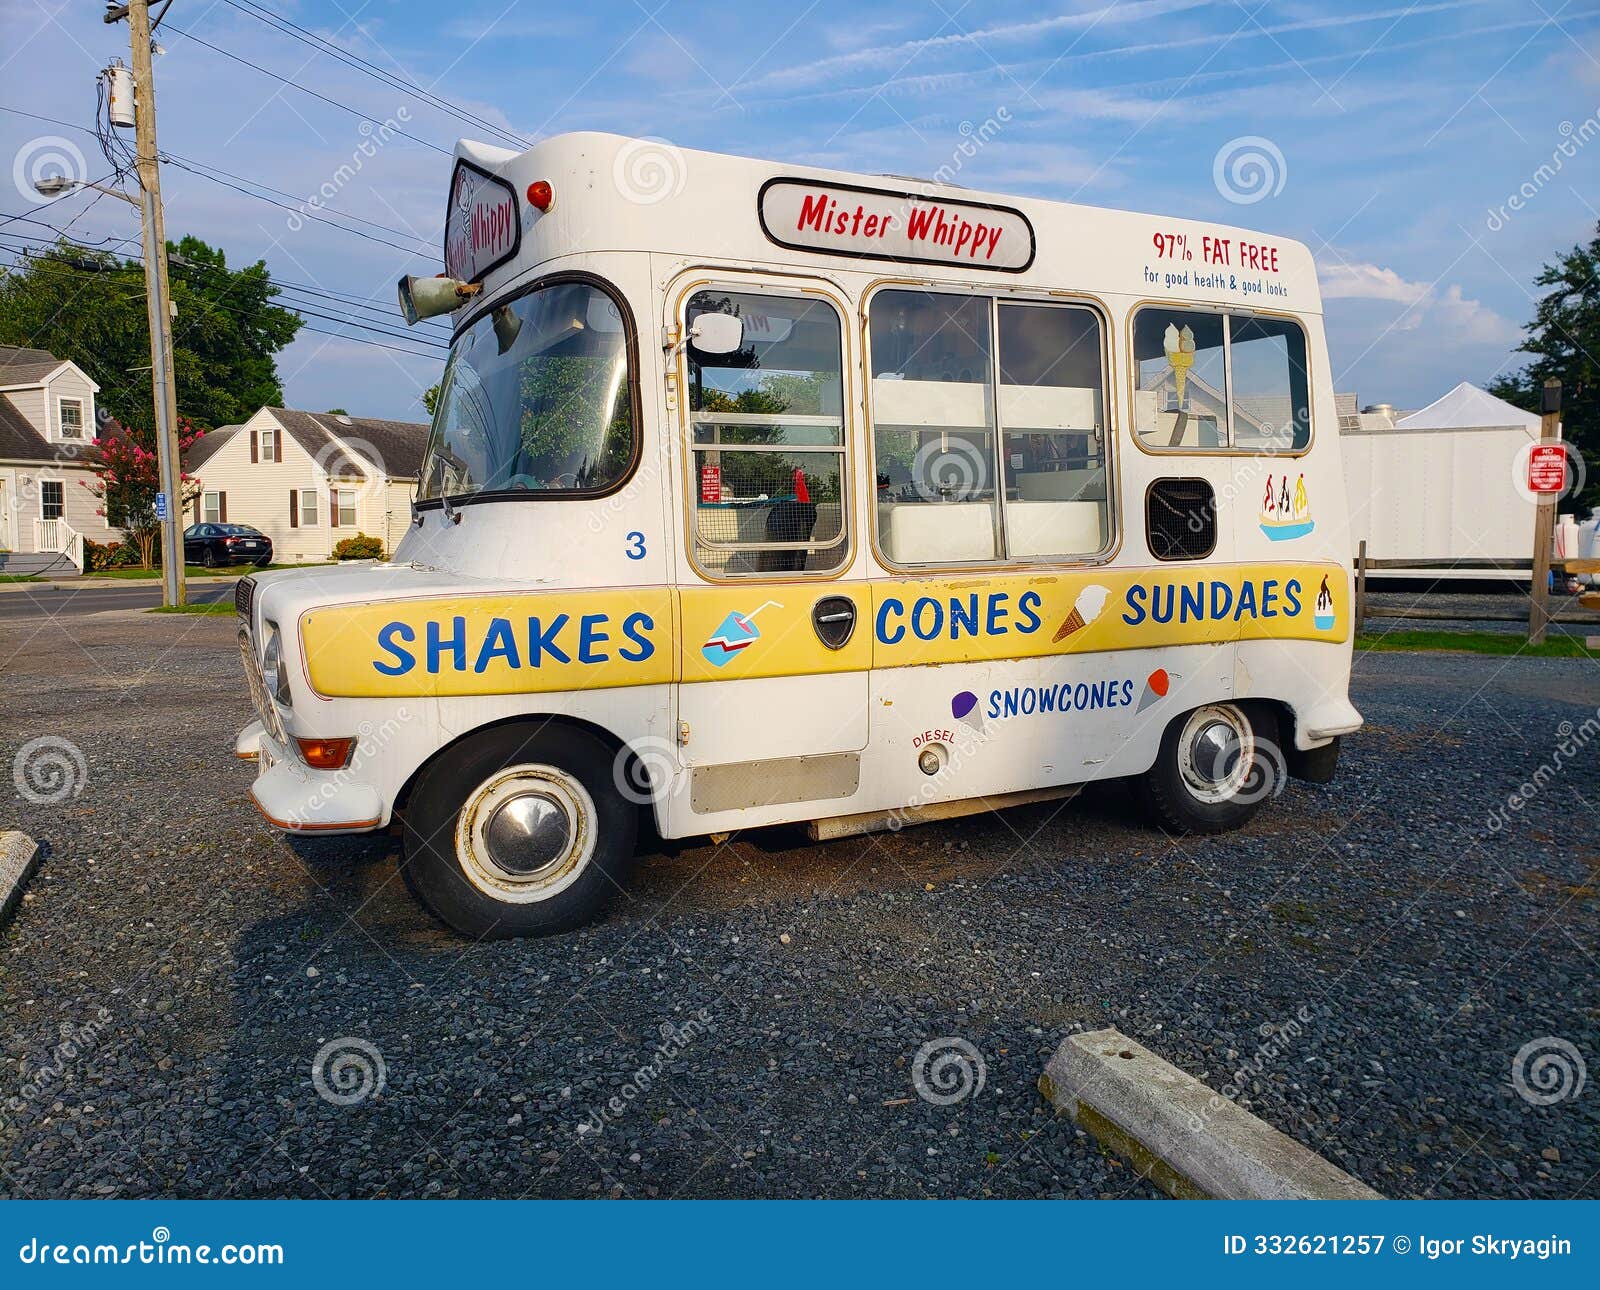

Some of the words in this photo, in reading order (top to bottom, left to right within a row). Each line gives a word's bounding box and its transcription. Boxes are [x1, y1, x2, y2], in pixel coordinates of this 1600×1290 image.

[797, 194, 892, 238] Mister
[907, 206, 1003, 260] Whippy
[1153, 232, 1192, 261] 97%
[1202, 236, 1231, 266] FAT
[1240, 241, 1279, 272] FREE
[1144, 266, 1159, 282] for
[1165, 271, 1188, 288] good
[1194, 271, 1225, 289] health
[1229, 275, 1237, 290] &
[1242, 279, 1262, 296] good
[1266, 281, 1288, 297] looks
[625, 531, 647, 561] 3
[875, 591, 1043, 645] CONES
[1122, 579, 1303, 627] SUNDAES
[373, 612, 655, 675] SHAKES
[987, 679, 1134, 719] SNOWCONES
[912, 729, 955, 750] DIESEL
